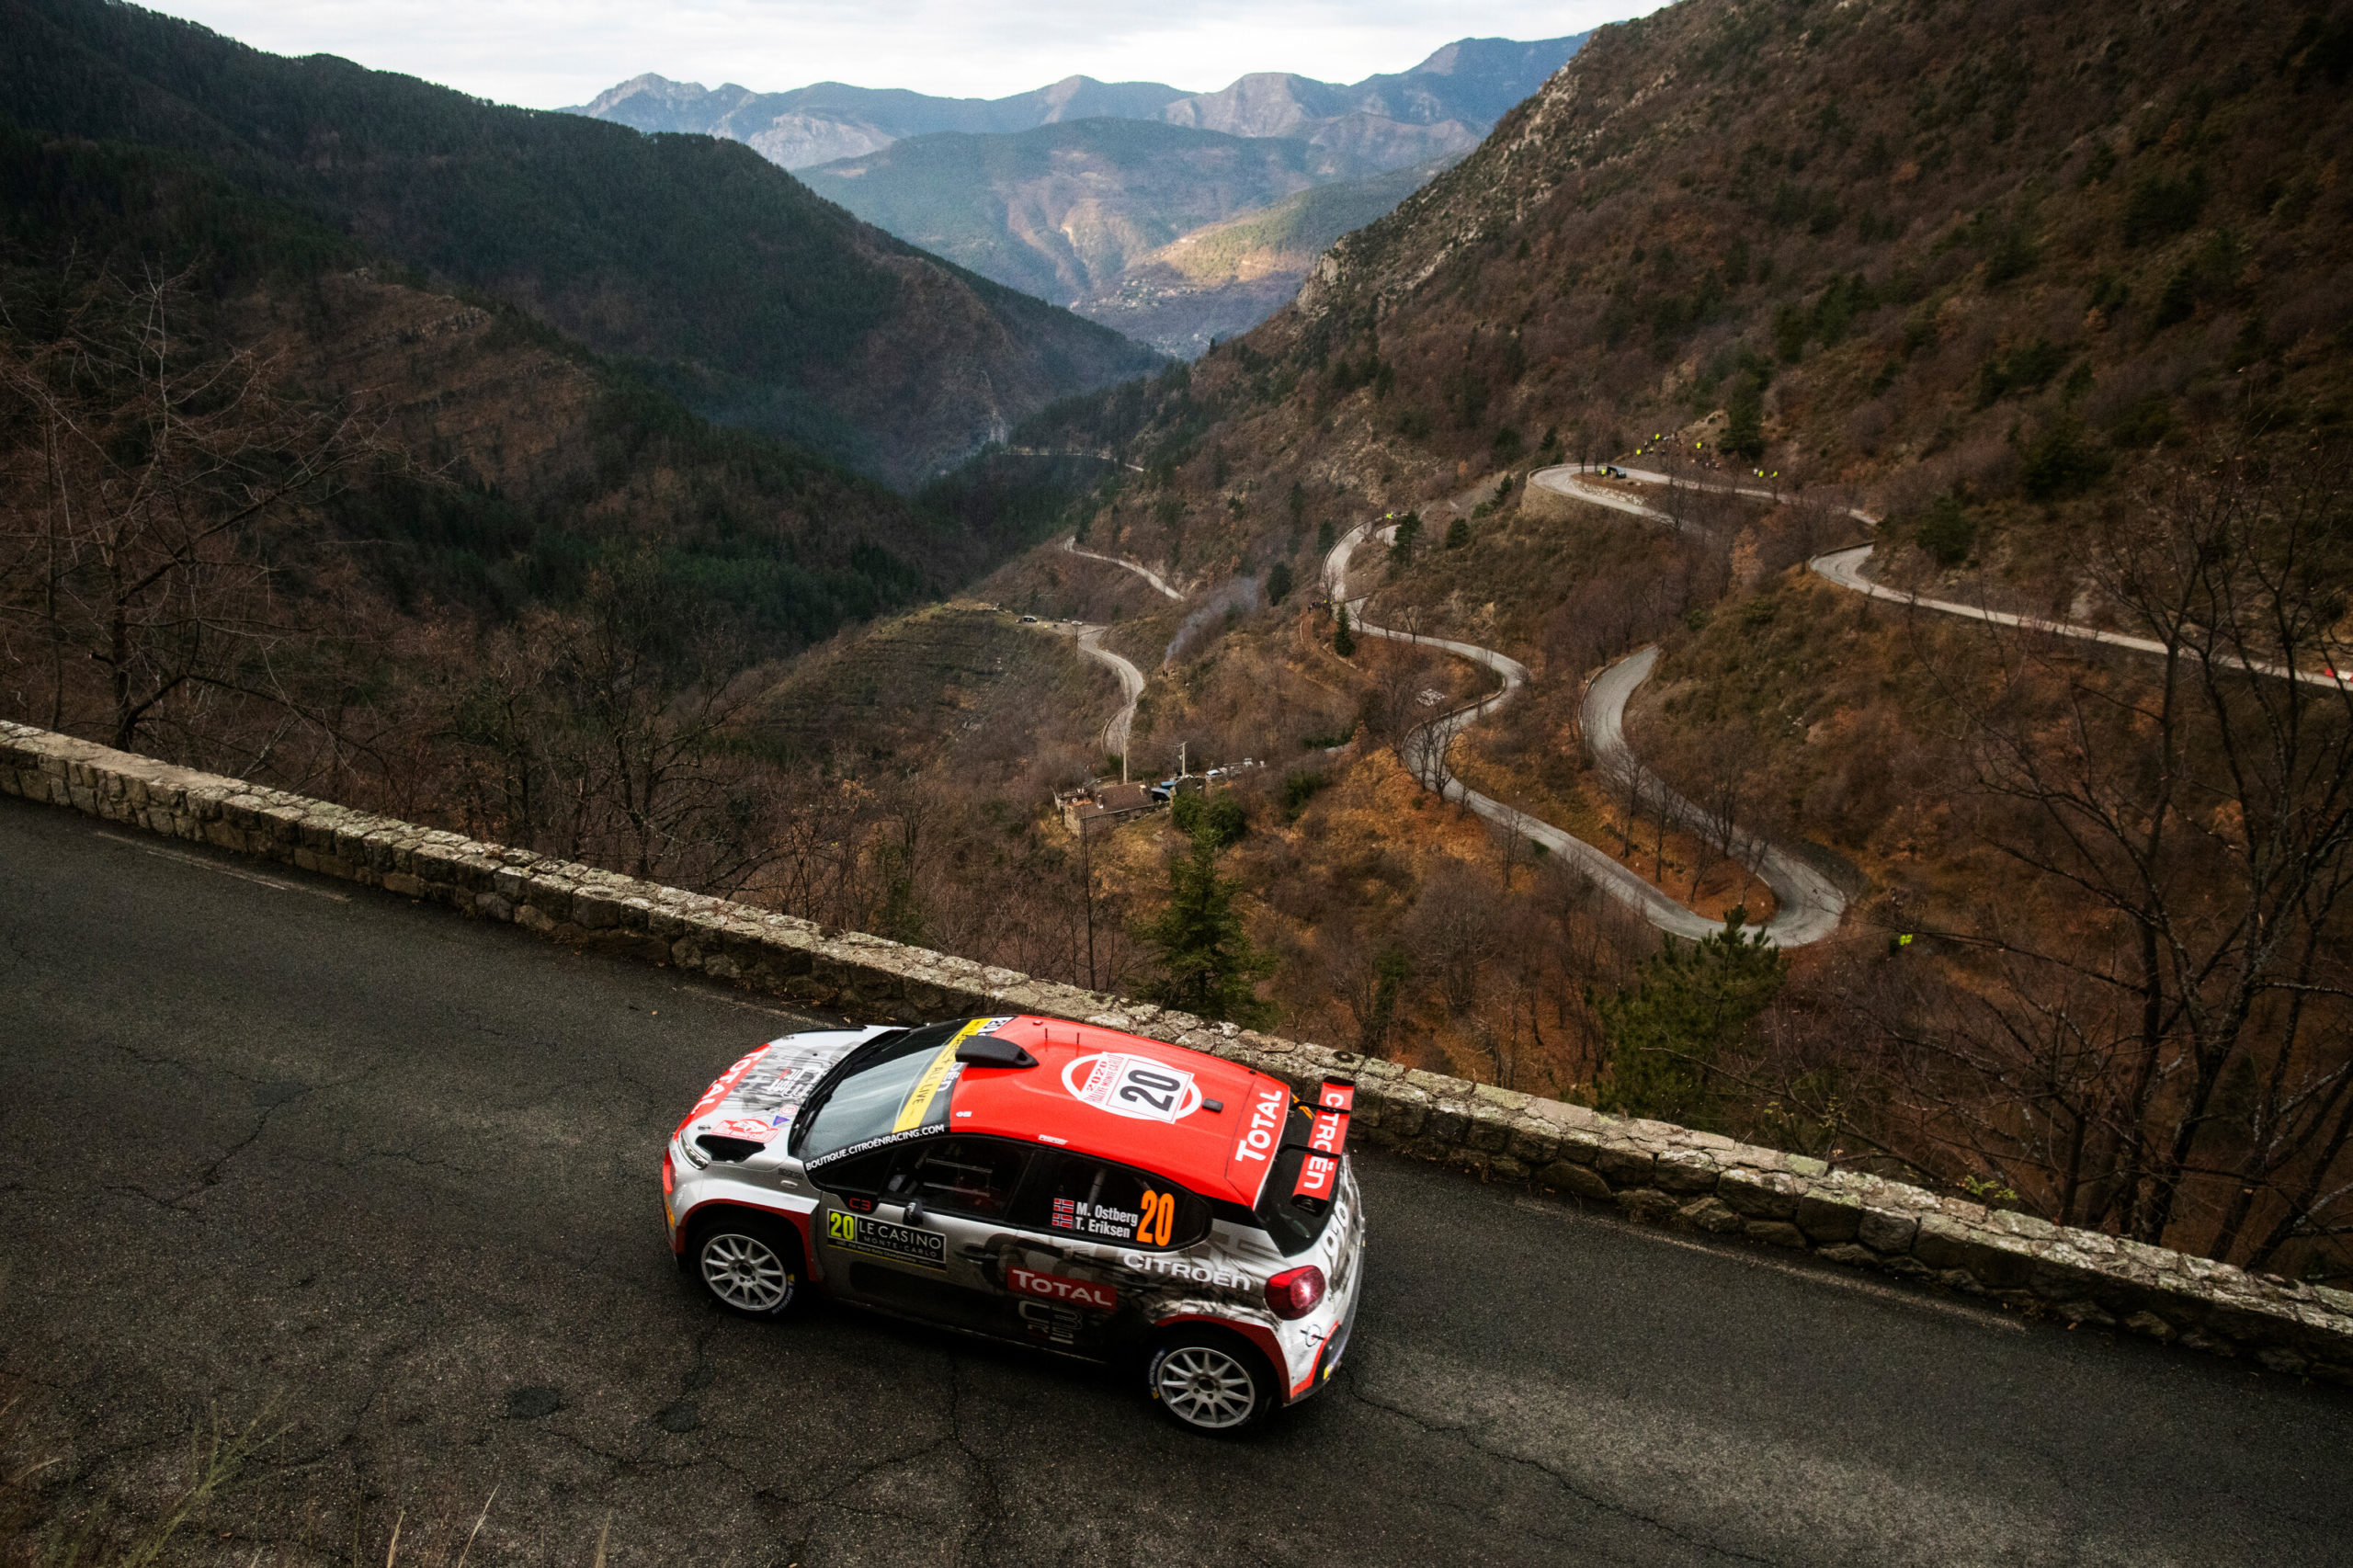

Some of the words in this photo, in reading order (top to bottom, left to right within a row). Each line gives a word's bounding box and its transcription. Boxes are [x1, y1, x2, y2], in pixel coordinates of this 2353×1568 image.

[690, 1046, 770, 1114] TOTAL
[1086, 1060, 1108, 1092] 2020
[1120, 1069, 1181, 1112] 20
[1234, 1090, 1283, 1162] TOTAL
[1303, 1093, 1344, 1189] CTROËN
[849, 1198, 871, 1211] C3
[1076, 1201, 1091, 1217] M.
[1095, 1205, 1139, 1227] Ostberg
[1136, 1189, 1175, 1247] 20
[830, 1212, 855, 1241] 20
[859, 1220, 874, 1235] LE
[878, 1225, 941, 1250] CASINO
[1075, 1217, 1086, 1231] T.
[1087, 1219, 1131, 1239] Eriksen
[1013, 1269, 1111, 1307] TOTAL
[1123, 1254, 1251, 1290] CITROËN
